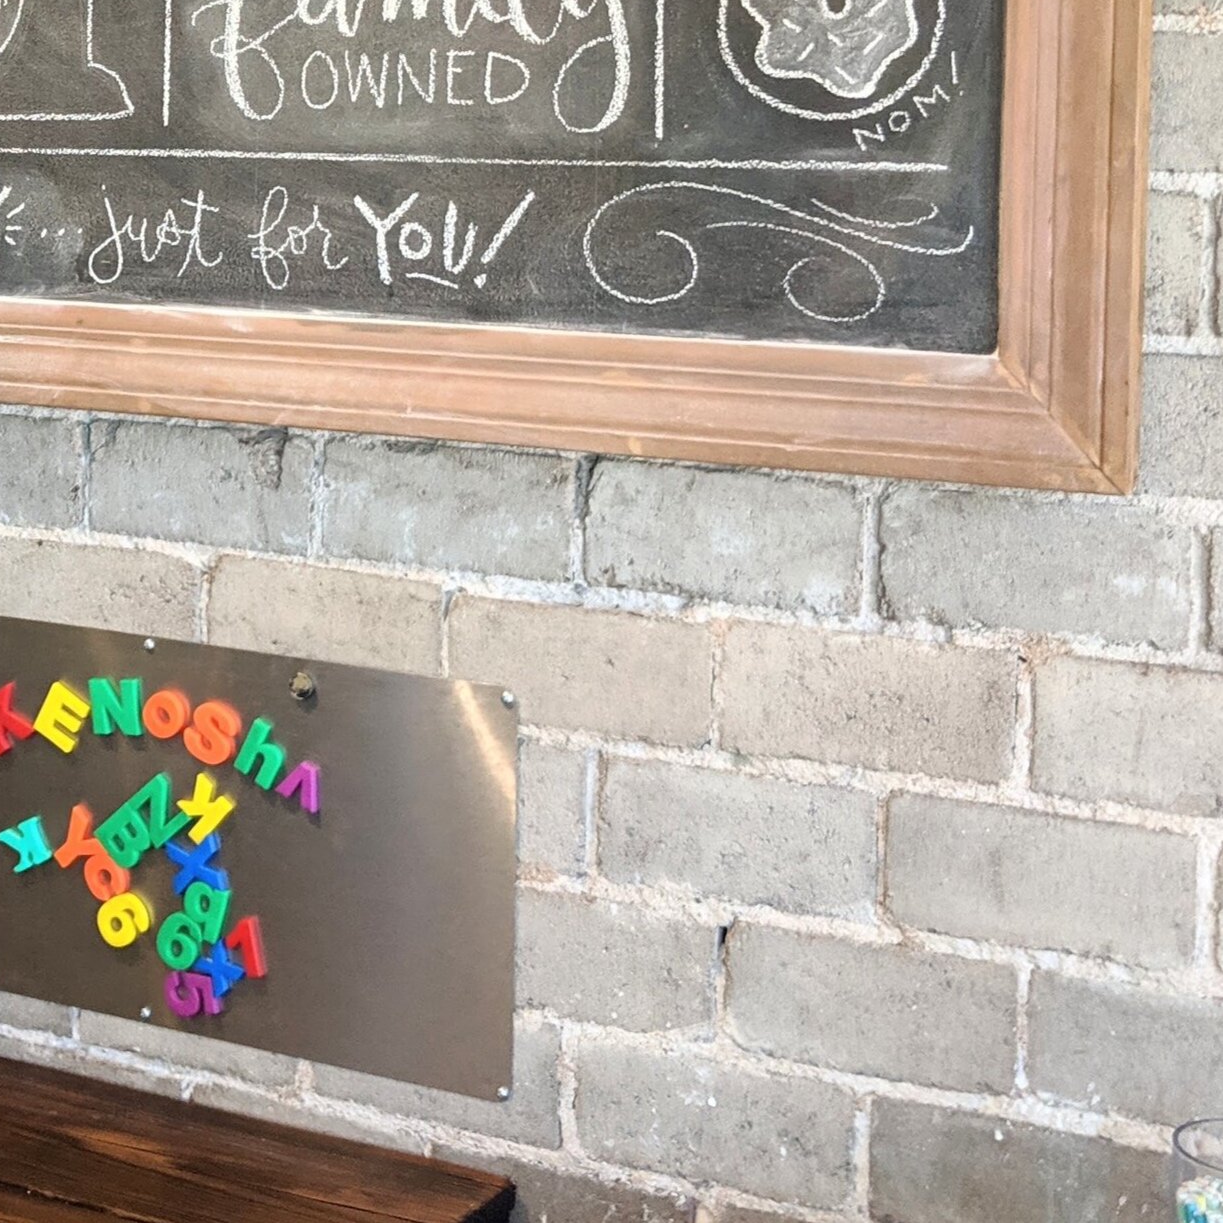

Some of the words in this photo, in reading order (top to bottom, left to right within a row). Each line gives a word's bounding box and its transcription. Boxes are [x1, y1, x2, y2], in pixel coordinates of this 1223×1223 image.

[301, 49, 531, 110] OWNED
[852, 50, 964, 151] NOM!
[88, 184, 224, 284] just
[248, 186, 349, 291] for
